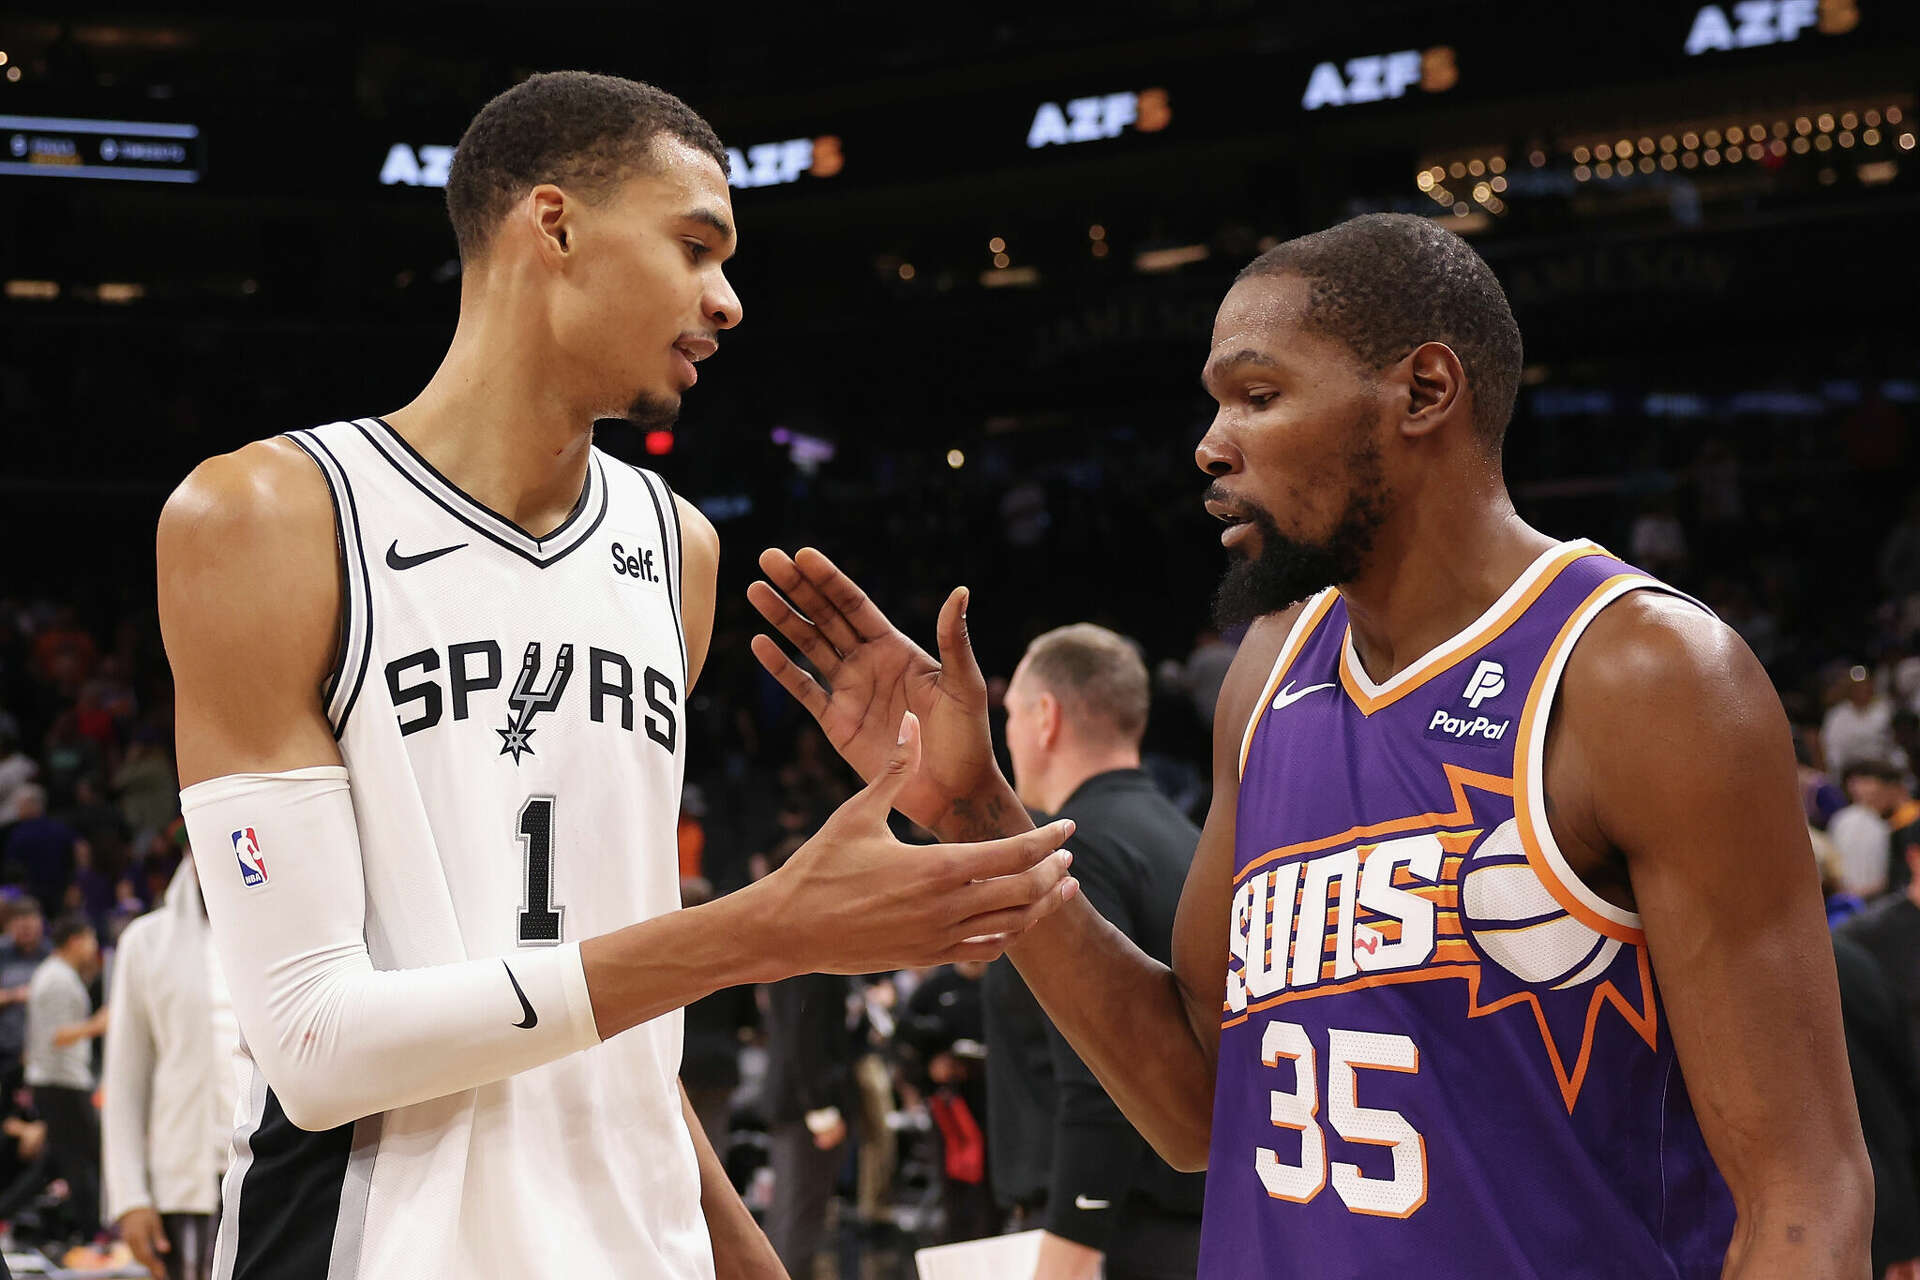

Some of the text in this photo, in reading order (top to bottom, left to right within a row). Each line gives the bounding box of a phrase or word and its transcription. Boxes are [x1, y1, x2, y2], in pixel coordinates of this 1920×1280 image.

[611, 542, 659, 583] Self.
[384, 640, 677, 766] SPURS
[1429, 710, 1510, 740] PayPal
[245, 872, 262, 884] NBA
[516, 795, 565, 947] 1
[1226, 833, 1444, 1014] SUNS
[1255, 1020, 1428, 1219] 35
